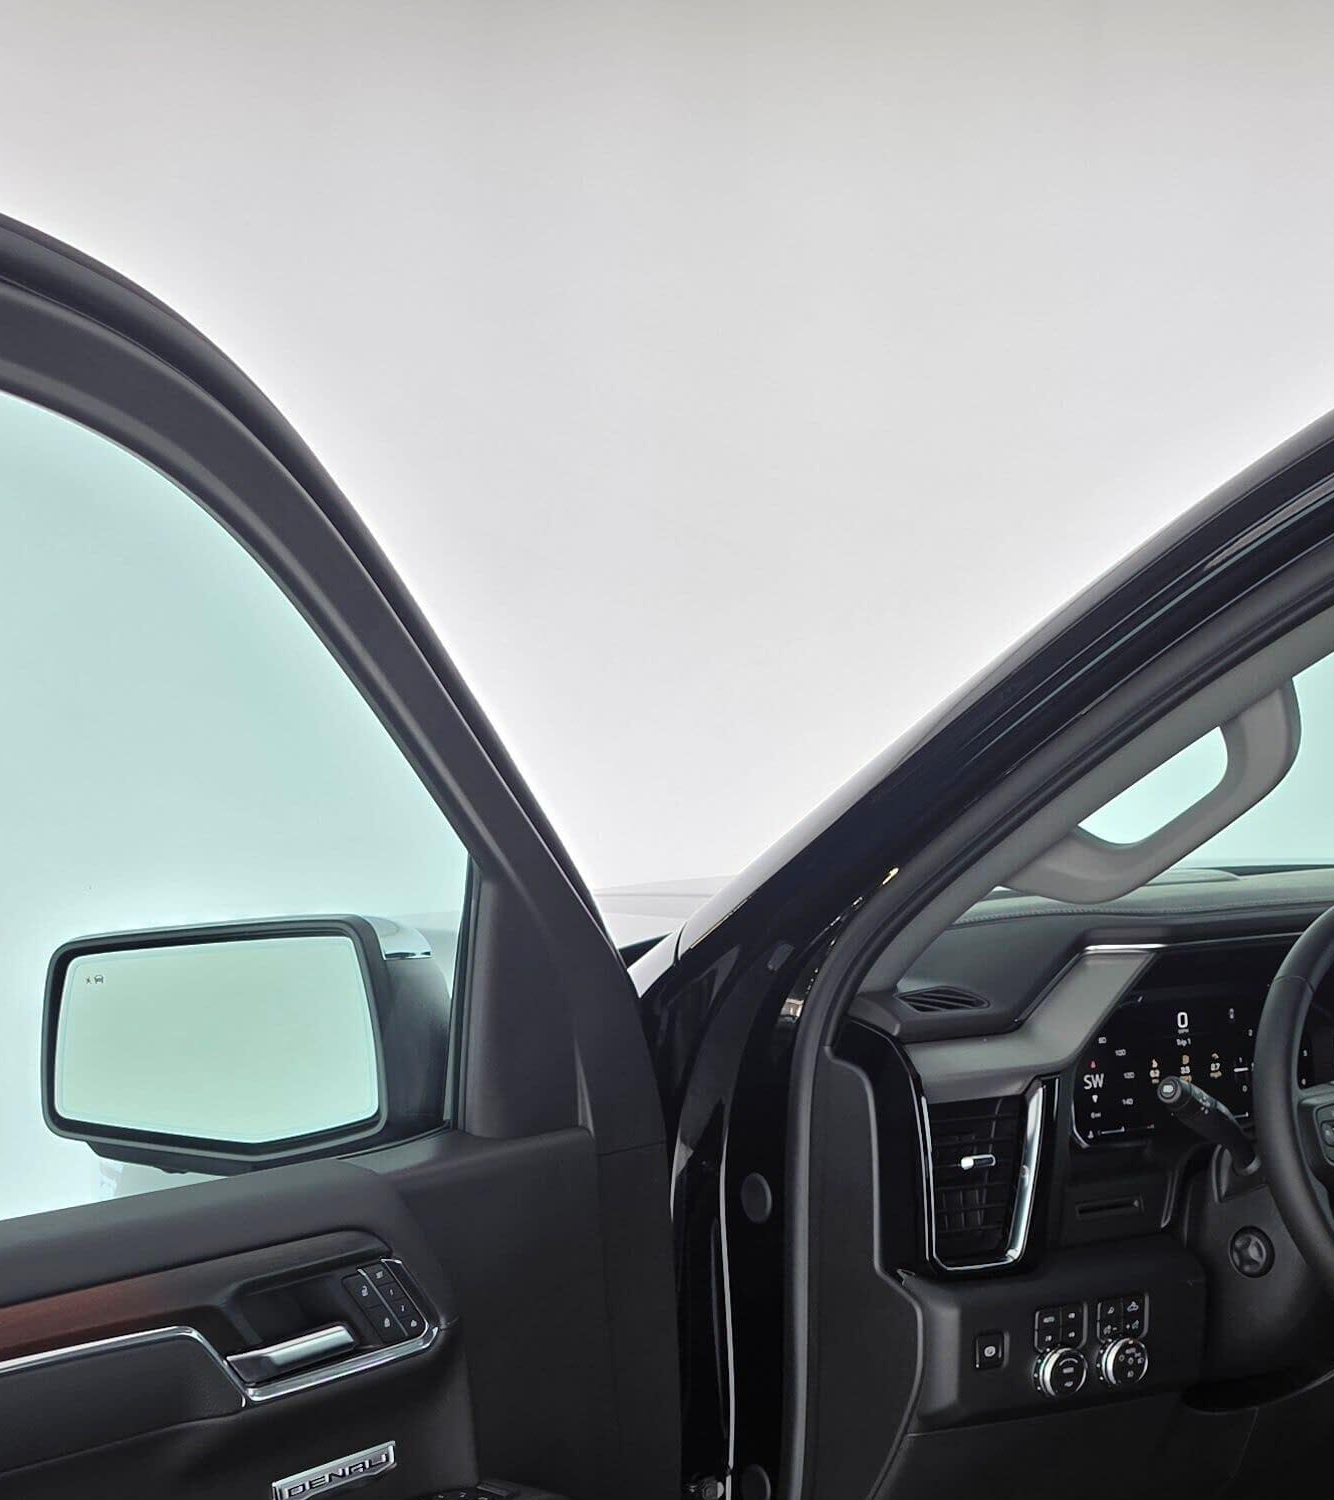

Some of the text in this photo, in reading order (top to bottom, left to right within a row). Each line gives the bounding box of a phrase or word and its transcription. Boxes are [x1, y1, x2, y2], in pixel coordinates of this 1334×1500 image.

[1177, 1012, 1189, 1028] 0
[1083, 1073, 1105, 1090] SW
[284, 1453, 387, 1500] DENALI
